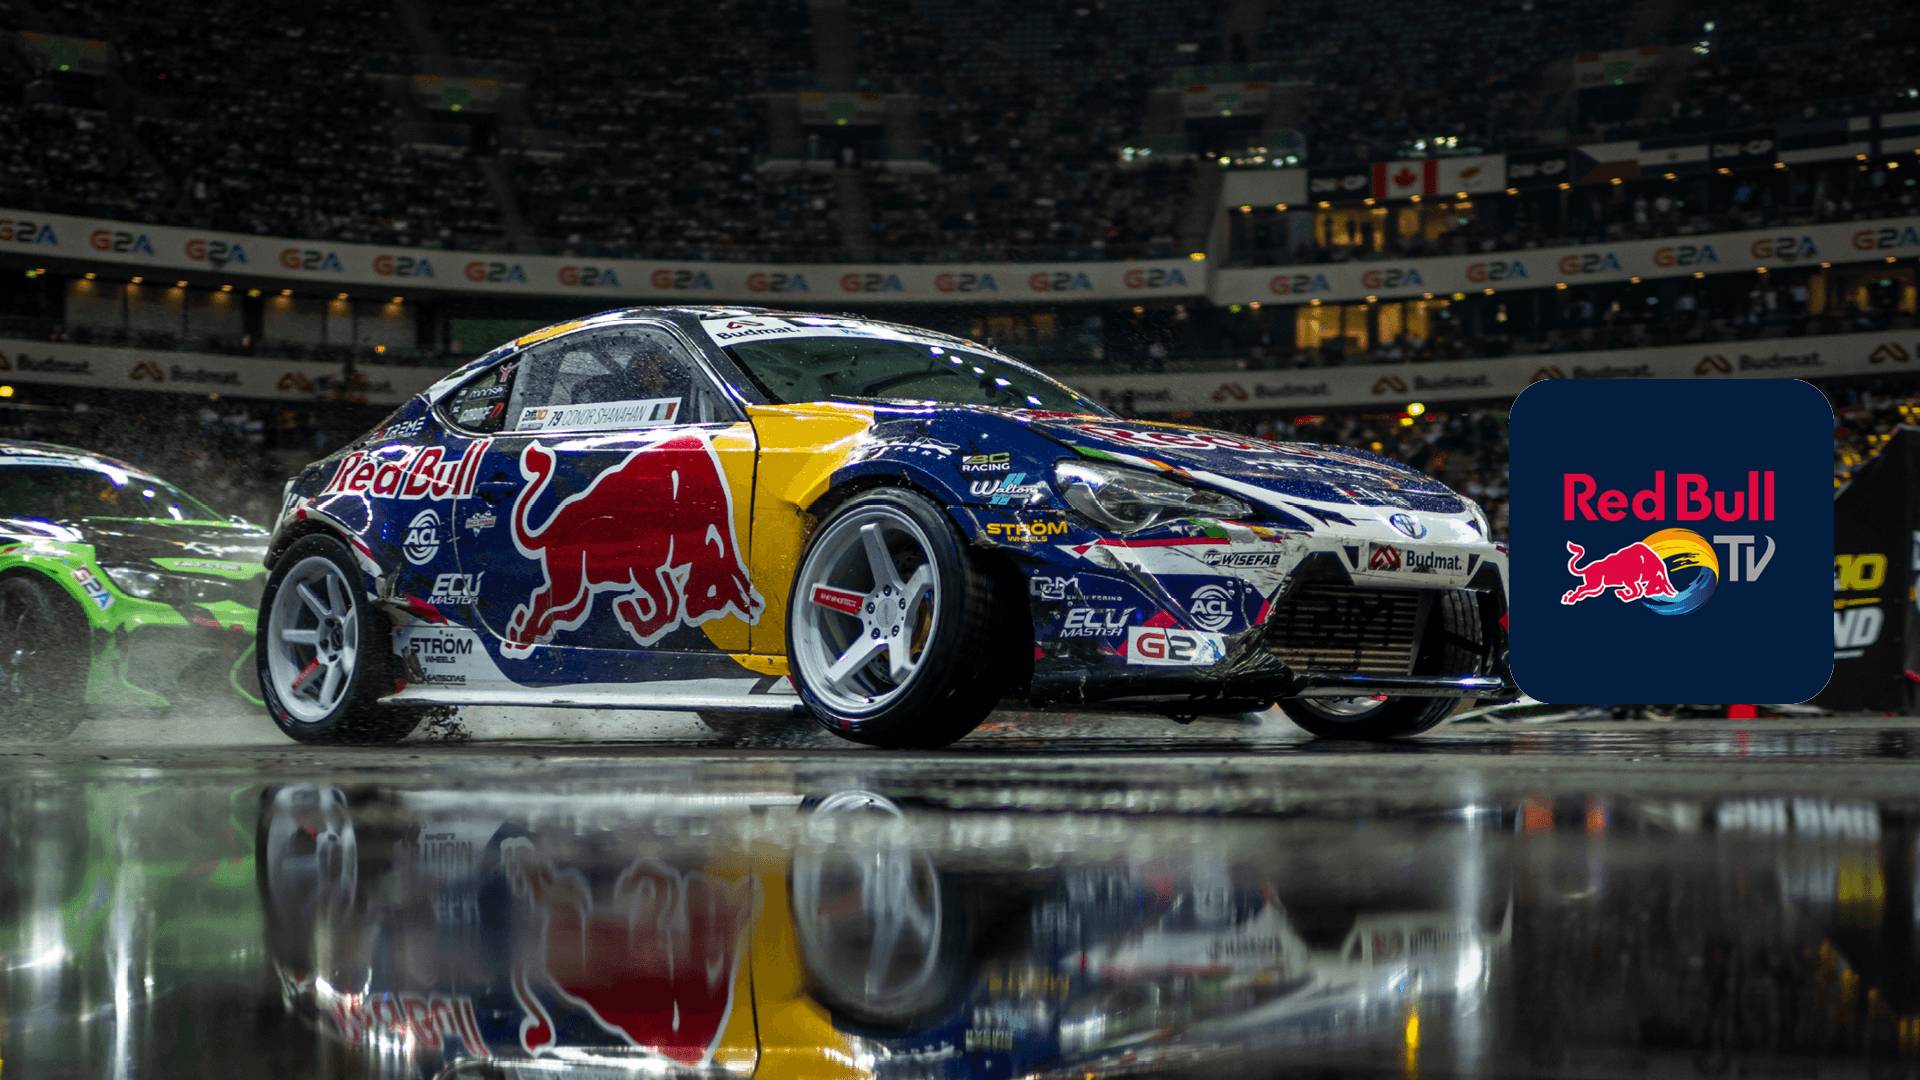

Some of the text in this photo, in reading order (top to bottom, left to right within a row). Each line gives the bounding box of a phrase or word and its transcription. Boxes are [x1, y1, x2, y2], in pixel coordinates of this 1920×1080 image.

[90, 229, 154, 255] G2A
[1750, 236, 1818, 260] G2A
[1851, 226, 1920, 251] G2A
[185, 239, 247, 264] G2A
[280, 248, 342, 272] G2A
[1653, 244, 1719, 268] G2A
[372, 254, 435, 278] G2A
[464, 262, 527, 283] G2A
[1465, 260, 1527, 282] G2A
[1557, 252, 1621, 275] G2A
[557, 265, 621, 288] G2A
[651, 269, 713, 290] G2A
[746, 272, 810, 293] G2A
[840, 273, 904, 293] G2A
[934, 273, 998, 293] G2A
[1028, 272, 1092, 291] G2A
[1123, 268, 1187, 290] G2A
[1269, 273, 1331, 295] G2A
[1361, 267, 1425, 290] G2A
[716, 326, 801, 340] Budmat.
[548, 411, 563, 426] 79
[562, 408, 595, 426] CONOR
[594, 405, 647, 424] SHANAHAN
[398, 438, 494, 500] Bull
[962, 463, 1010, 471] RACING
[404, 528, 440, 545] ACL
[987, 519, 1068, 535] STRÖM
[1222, 552, 1281, 566] WISEFAB
[1406, 550, 1462, 570] Budmat.
[73, 566, 113, 609] G2A
[432, 571, 485, 596] ECU
[427, 596, 479, 604] MASTER
[1190, 600, 1233, 616] ACL
[1064, 607, 1136, 629] ECU
[409, 632, 473, 655] STRÖM
